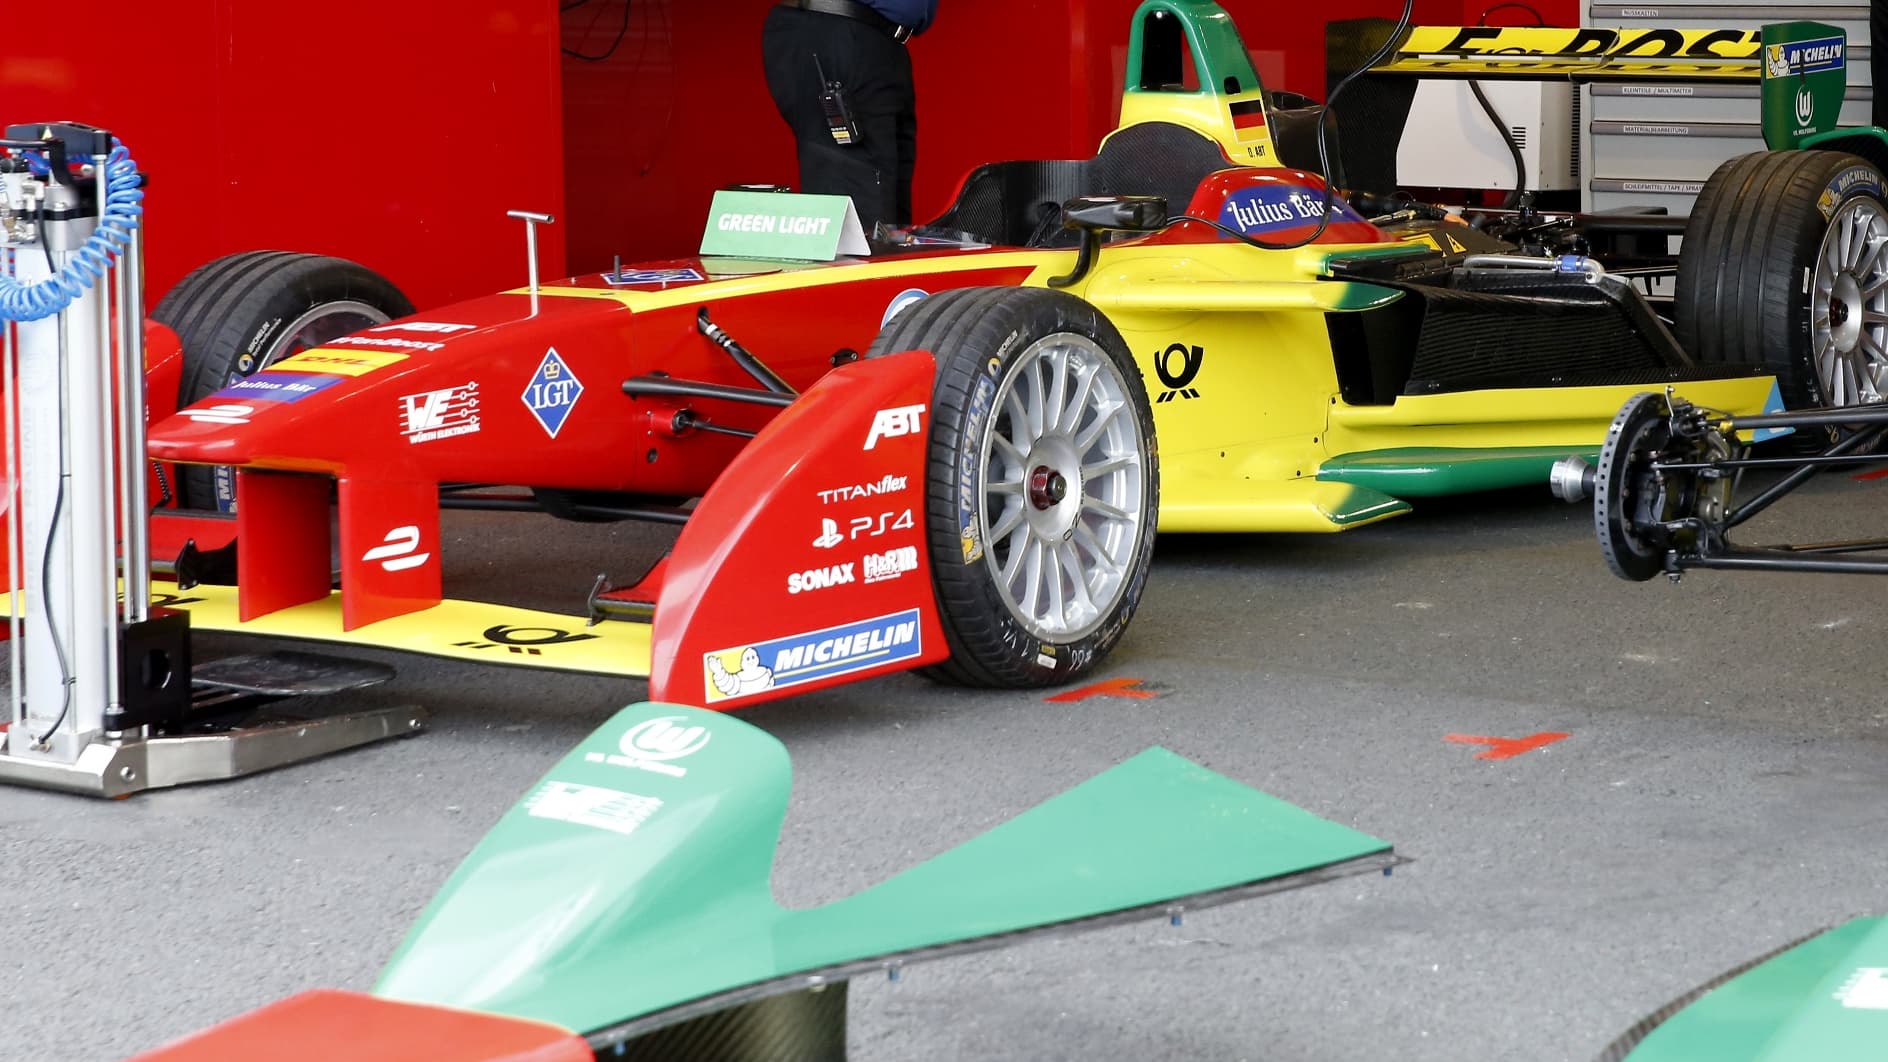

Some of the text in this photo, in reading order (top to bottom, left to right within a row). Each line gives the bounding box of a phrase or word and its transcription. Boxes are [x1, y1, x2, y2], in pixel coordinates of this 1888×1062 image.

[1790, 44, 1842, 65] MCHELIN
[1839, 170, 1877, 191] MICHELIN
[718, 213, 831, 235] GREEN LIGHT
[1227, 198, 1293, 232] Julius
[533, 379, 573, 410] LGT
[864, 404, 926, 450] ABT
[817, 475, 907, 504] TITANflex
[850, 509, 914, 540] PS4
[788, 563, 854, 594] SONAX
[774, 621, 916, 672] MICHELIN
